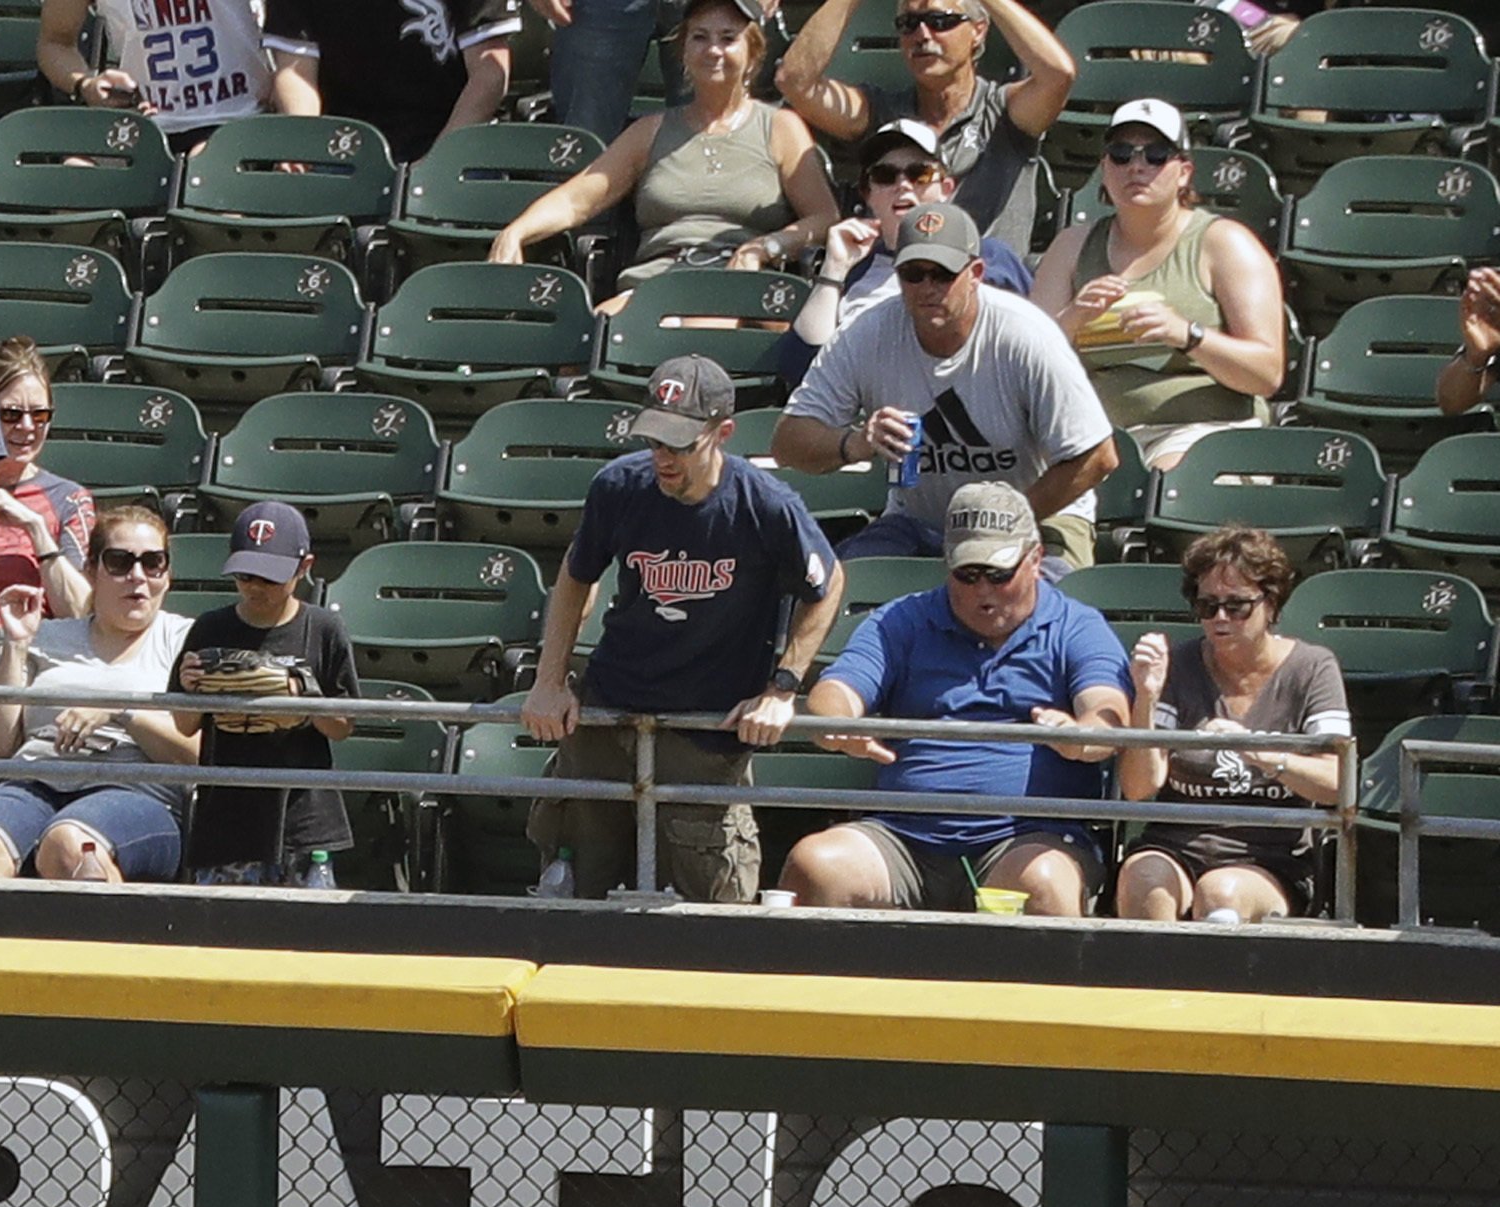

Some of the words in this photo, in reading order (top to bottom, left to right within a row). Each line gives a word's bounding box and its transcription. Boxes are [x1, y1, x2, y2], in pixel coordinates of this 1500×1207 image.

[143, 26, 220, 81] 23
[143, 72, 248, 112] LL-STAR
[920, 443, 1017, 474] didas
[626, 549, 736, 598] Twins
[1170, 777, 1230, 799] WHIT
